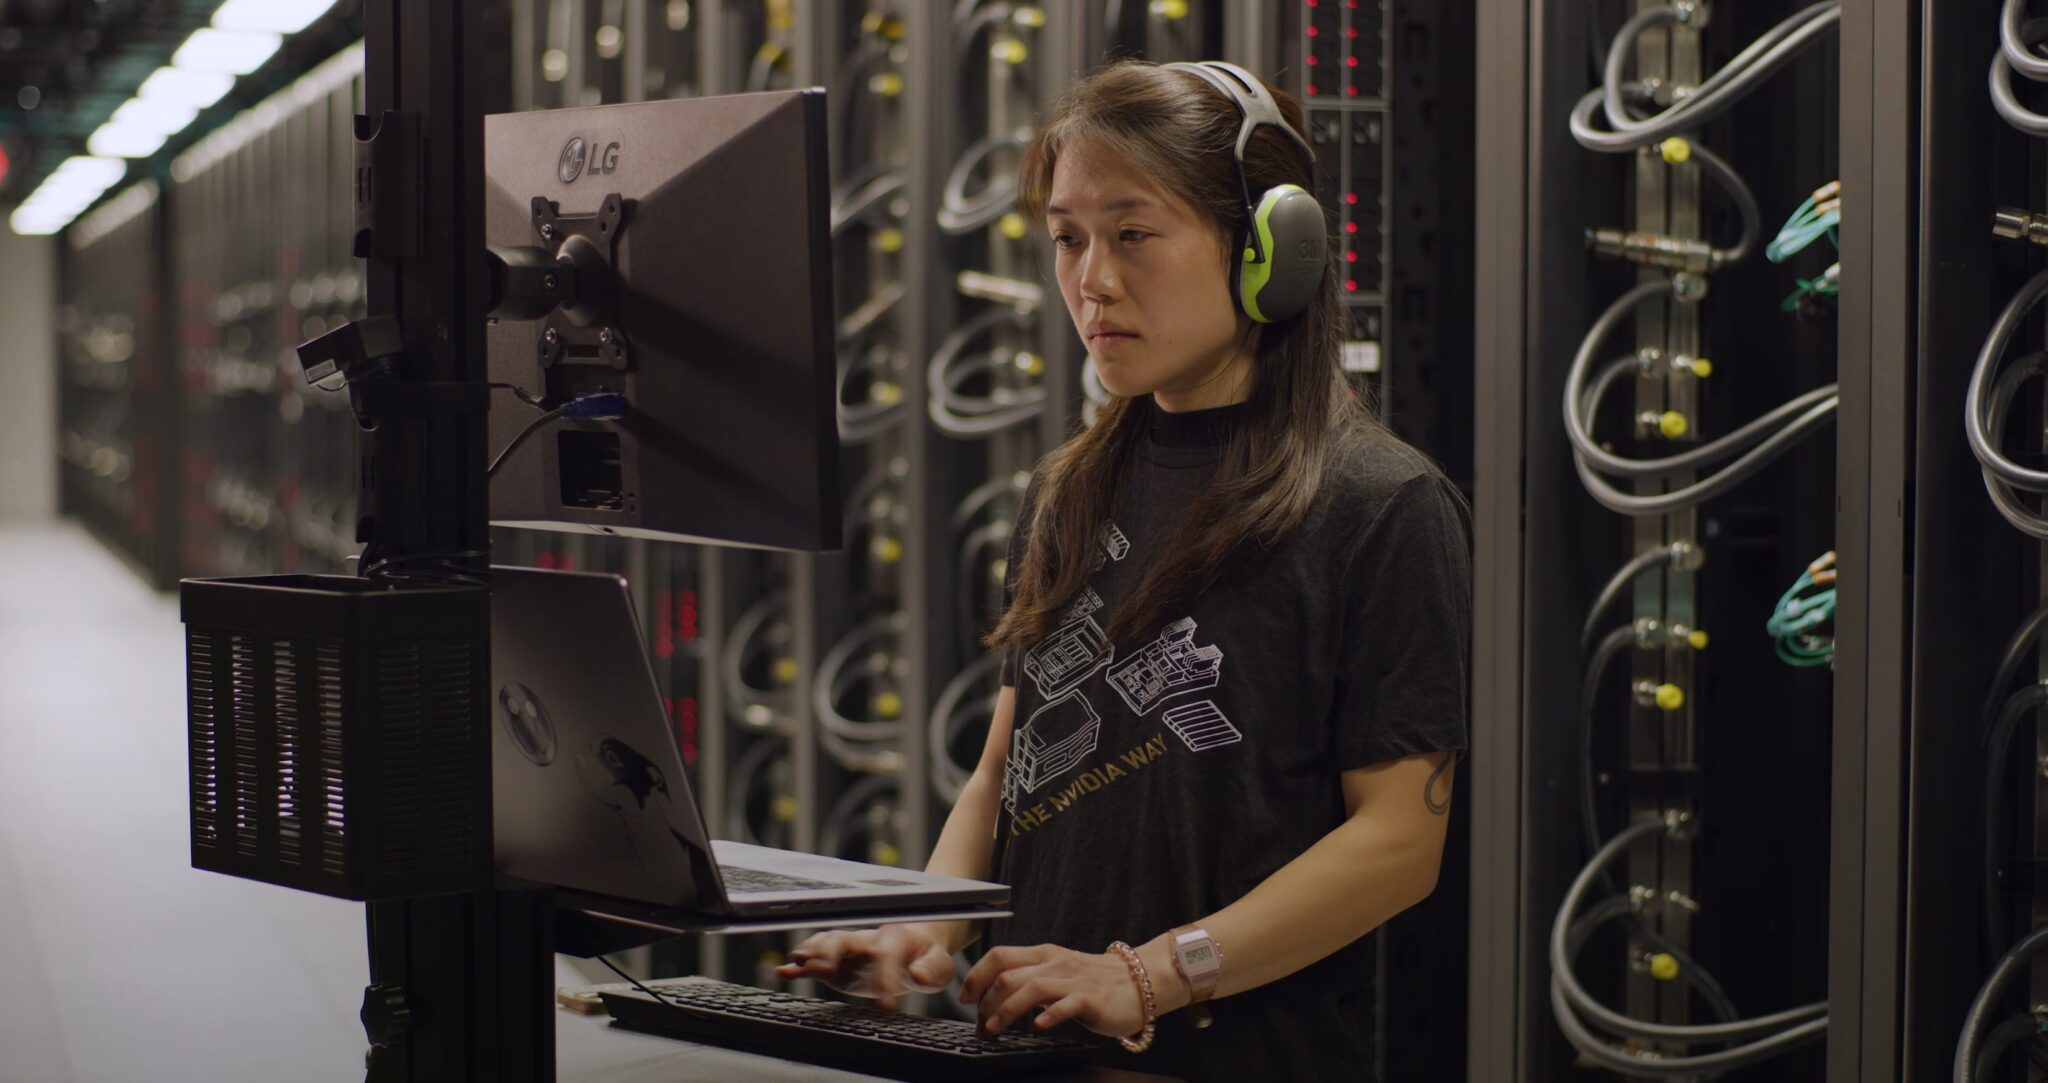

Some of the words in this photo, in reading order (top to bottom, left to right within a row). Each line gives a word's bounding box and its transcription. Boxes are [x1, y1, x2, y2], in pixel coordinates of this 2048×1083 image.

[587, 141, 621, 176] LG
[1048, 762, 1128, 812] NVIDIA
[1120, 732, 1168, 769] WAY
